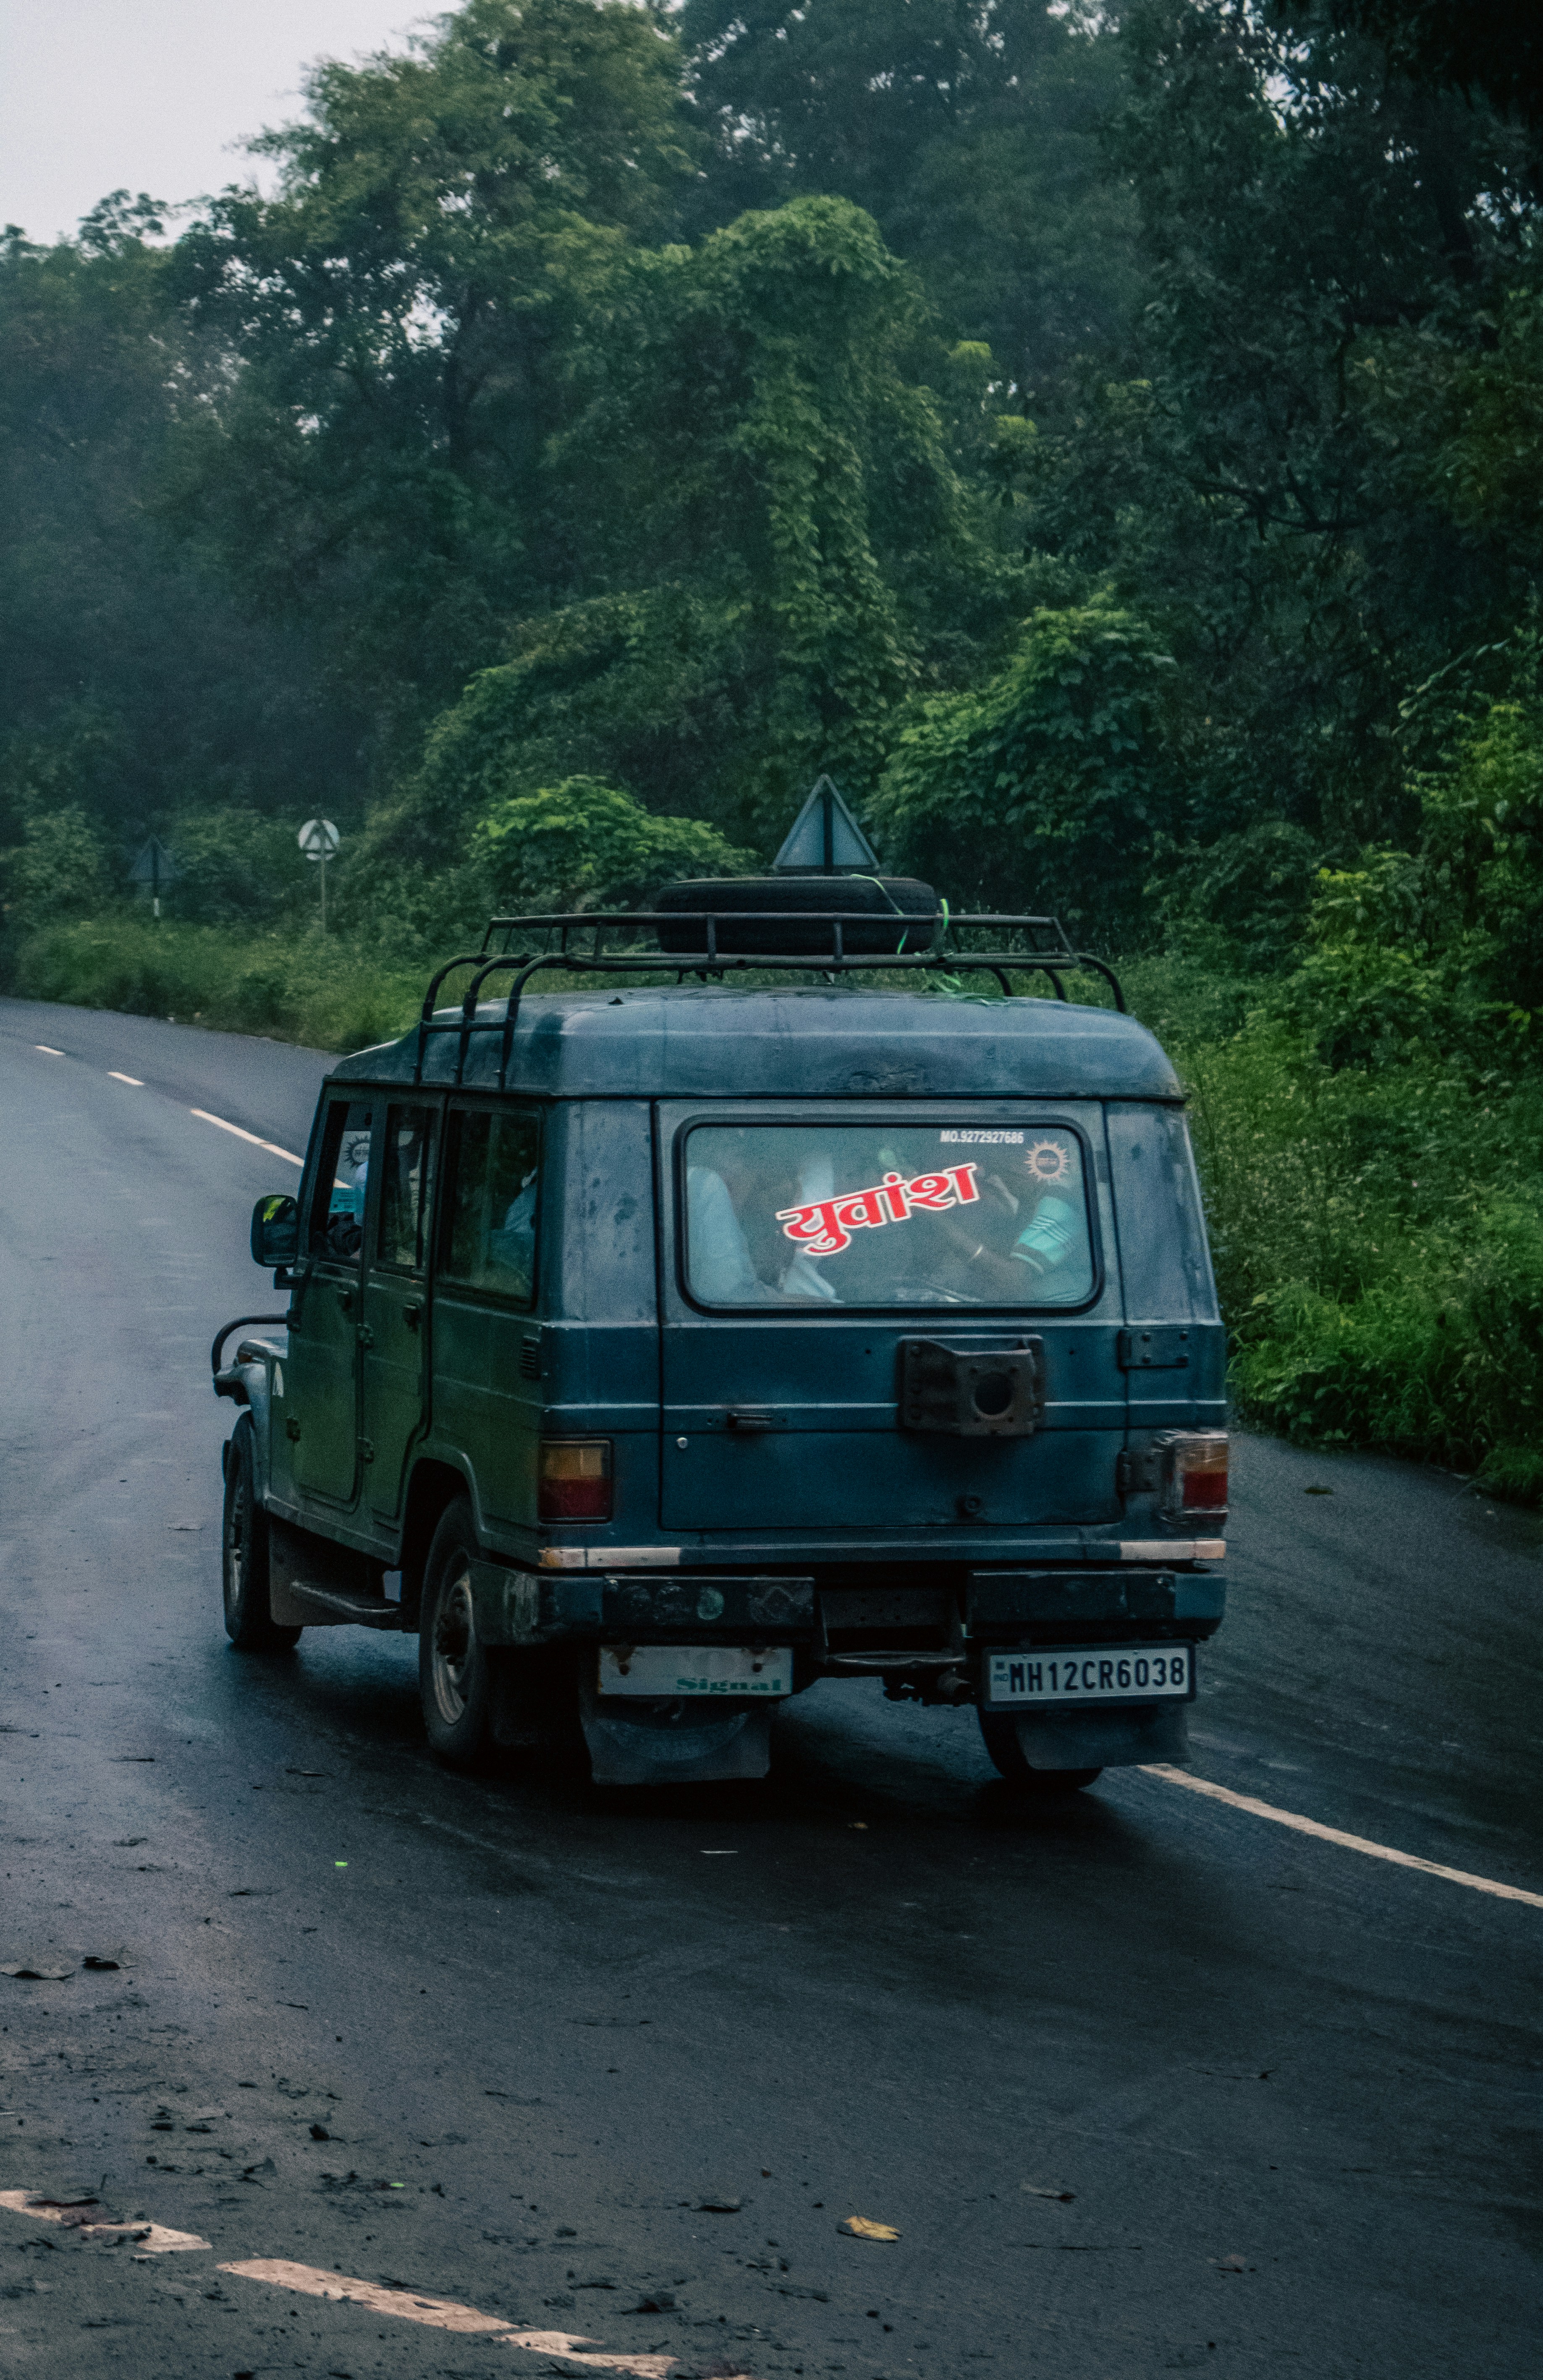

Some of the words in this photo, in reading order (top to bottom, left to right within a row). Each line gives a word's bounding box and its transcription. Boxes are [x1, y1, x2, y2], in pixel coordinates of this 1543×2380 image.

[775, 1163, 980, 1255] युवांश
[676, 1677, 781, 1693] Signal
[1009, 1657, 1184, 1692] MH12CR6038
